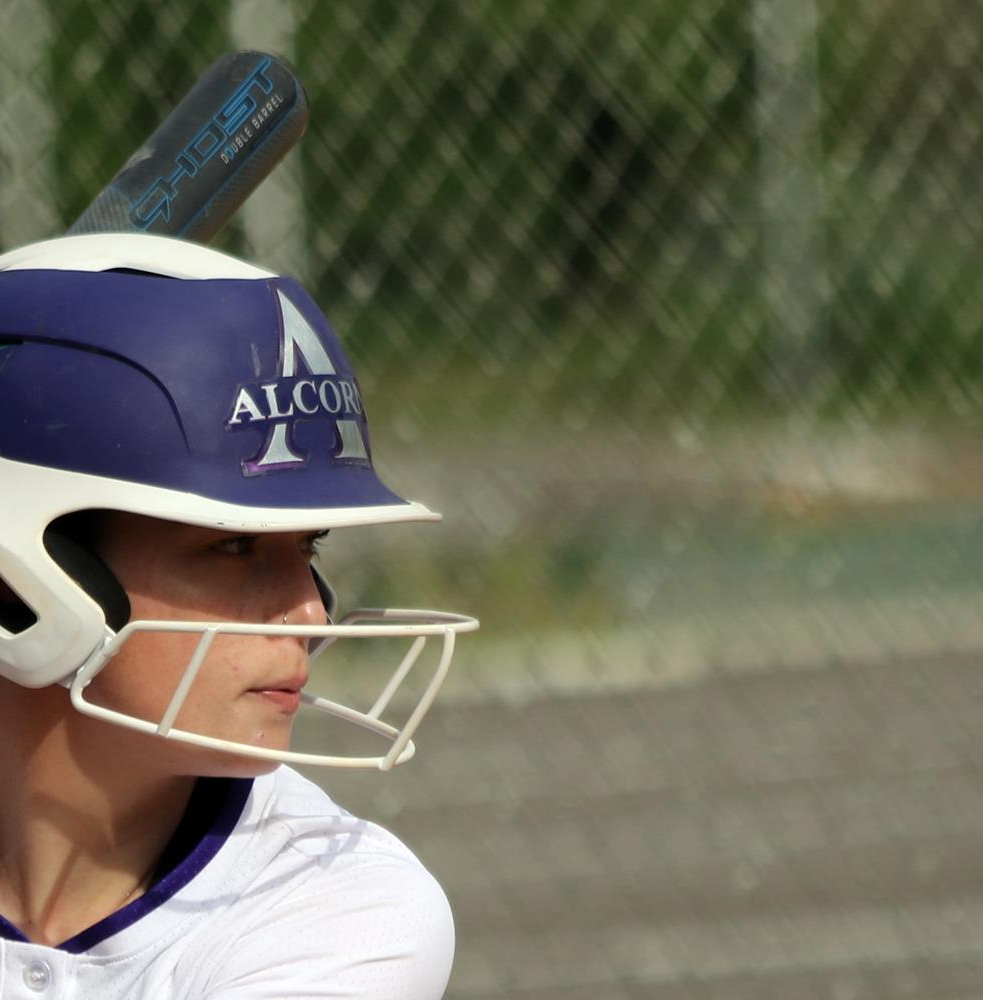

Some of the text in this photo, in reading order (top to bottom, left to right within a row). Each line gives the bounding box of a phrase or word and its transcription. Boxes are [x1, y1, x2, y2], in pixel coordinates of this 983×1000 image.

[128, 57, 274, 232] GHOST
[220, 94, 284, 165] DOUBLE BARREL
